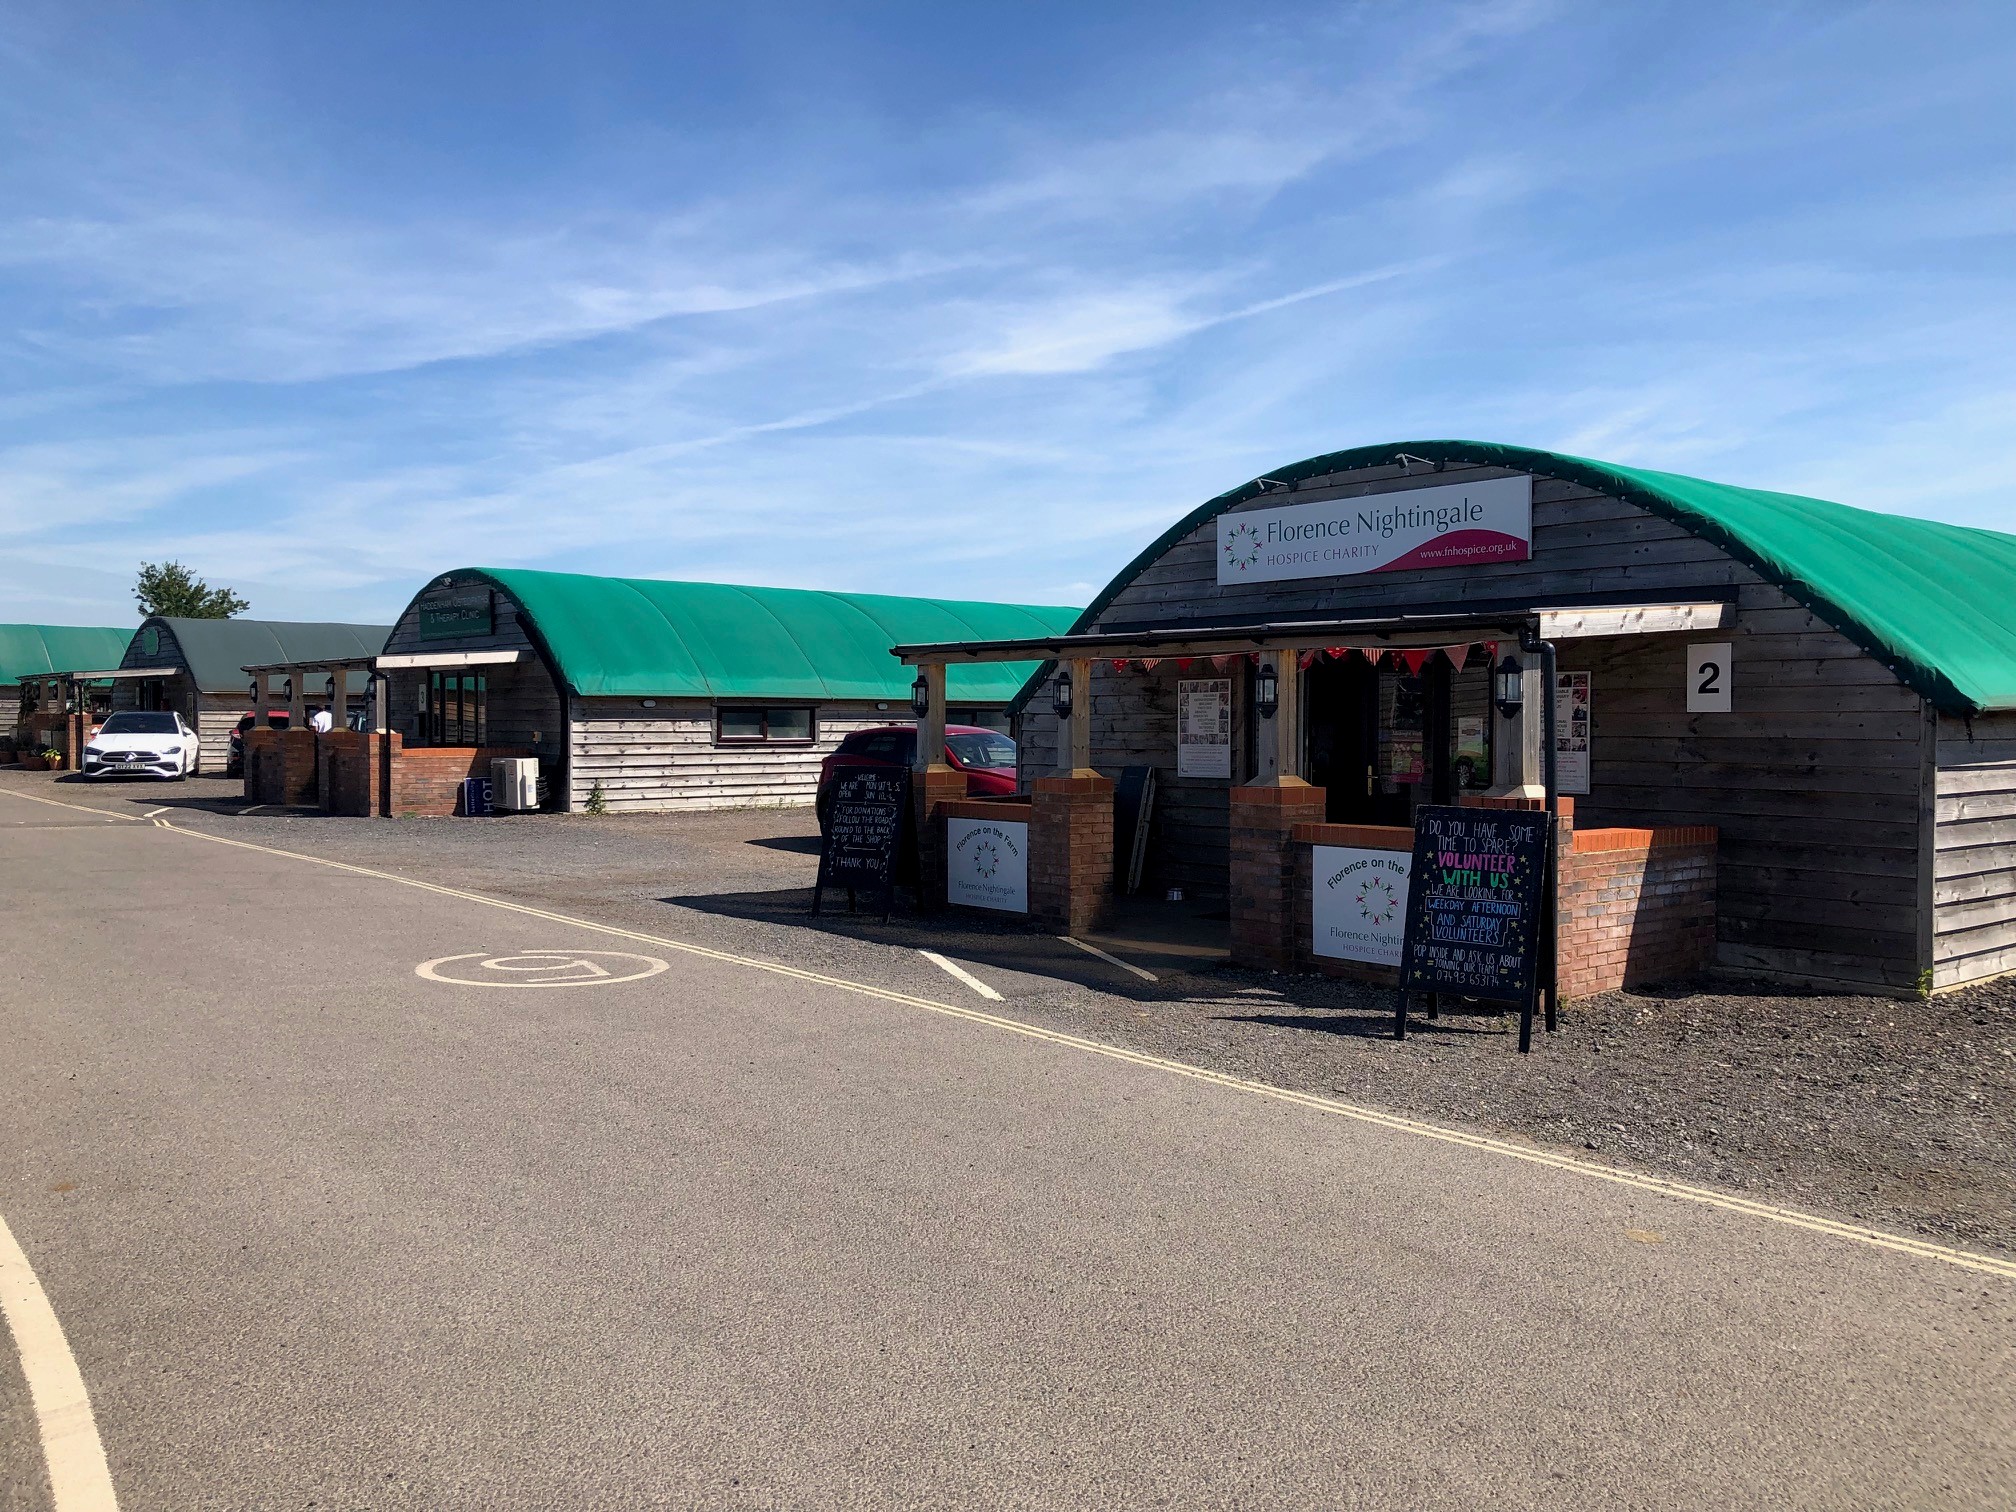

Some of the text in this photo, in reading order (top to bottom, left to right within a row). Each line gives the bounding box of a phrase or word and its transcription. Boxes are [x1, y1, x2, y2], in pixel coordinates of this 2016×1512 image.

[1267, 497, 1484, 544] Florence Nightingale
[1267, 544, 1380, 566] HOSPICE CHARITY
[1420, 540, 1517, 559] www.fnhospice.org.uk
[1698, 662, 1720, 694] 2
[421, 691, 425, 704] 3
[838, 790, 852, 799] OPEN
[840, 781, 858, 790] WE ARE
[865, 781, 877, 790] MON
[483, 780, 494, 812] HOT
[864, 790, 876, 800] SUN
[842, 806, 886, 815] FOR DONATIONS
[839, 815, 889, 825] FOLLOW THE ROAD
[835, 826, 890, 834] ROUND TO THE BACK
[841, 834, 881, 843] OF THE SHOP
[1429, 819, 1535, 843] DO YOU HAVE SOME
[956, 828, 982, 852] Florence
[993, 827, 1004, 839] the
[1004, 835, 1019, 857] Farm
[1438, 835, 1518, 855] TIME TO SPARE?
[836, 857, 880, 870] THANK YOU
[1438, 851, 1515, 874] VOLUNTEER
[1326, 859, 1368, 890] Florence
[1371, 859, 1384, 868] on
[1388, 860, 1405, 875] the
[1442, 869, 1509, 889] WITH US
[958, 880, 1016, 897] Florence Nightingale
[1432, 883, 1514, 901] WE ARE LOOKING FOR
[1428, 899, 1518, 916] WEEKDAY AFTERNOON
[1437, 913, 1502, 932] AND SATURDAY
[1330, 927, 1404, 947] Florence Nightin
[1436, 926, 1500, 944] VOLUNTEERS
[1343, 944, 1402, 958] HOSPICE CHARI
[1413, 944, 1522, 968] POP INSIDE AND ASK US ABOUT
[1434, 958, 1499, 976] JOINING OUR TEAM!
[1436, 969, 1499, 987] 07493 653174
